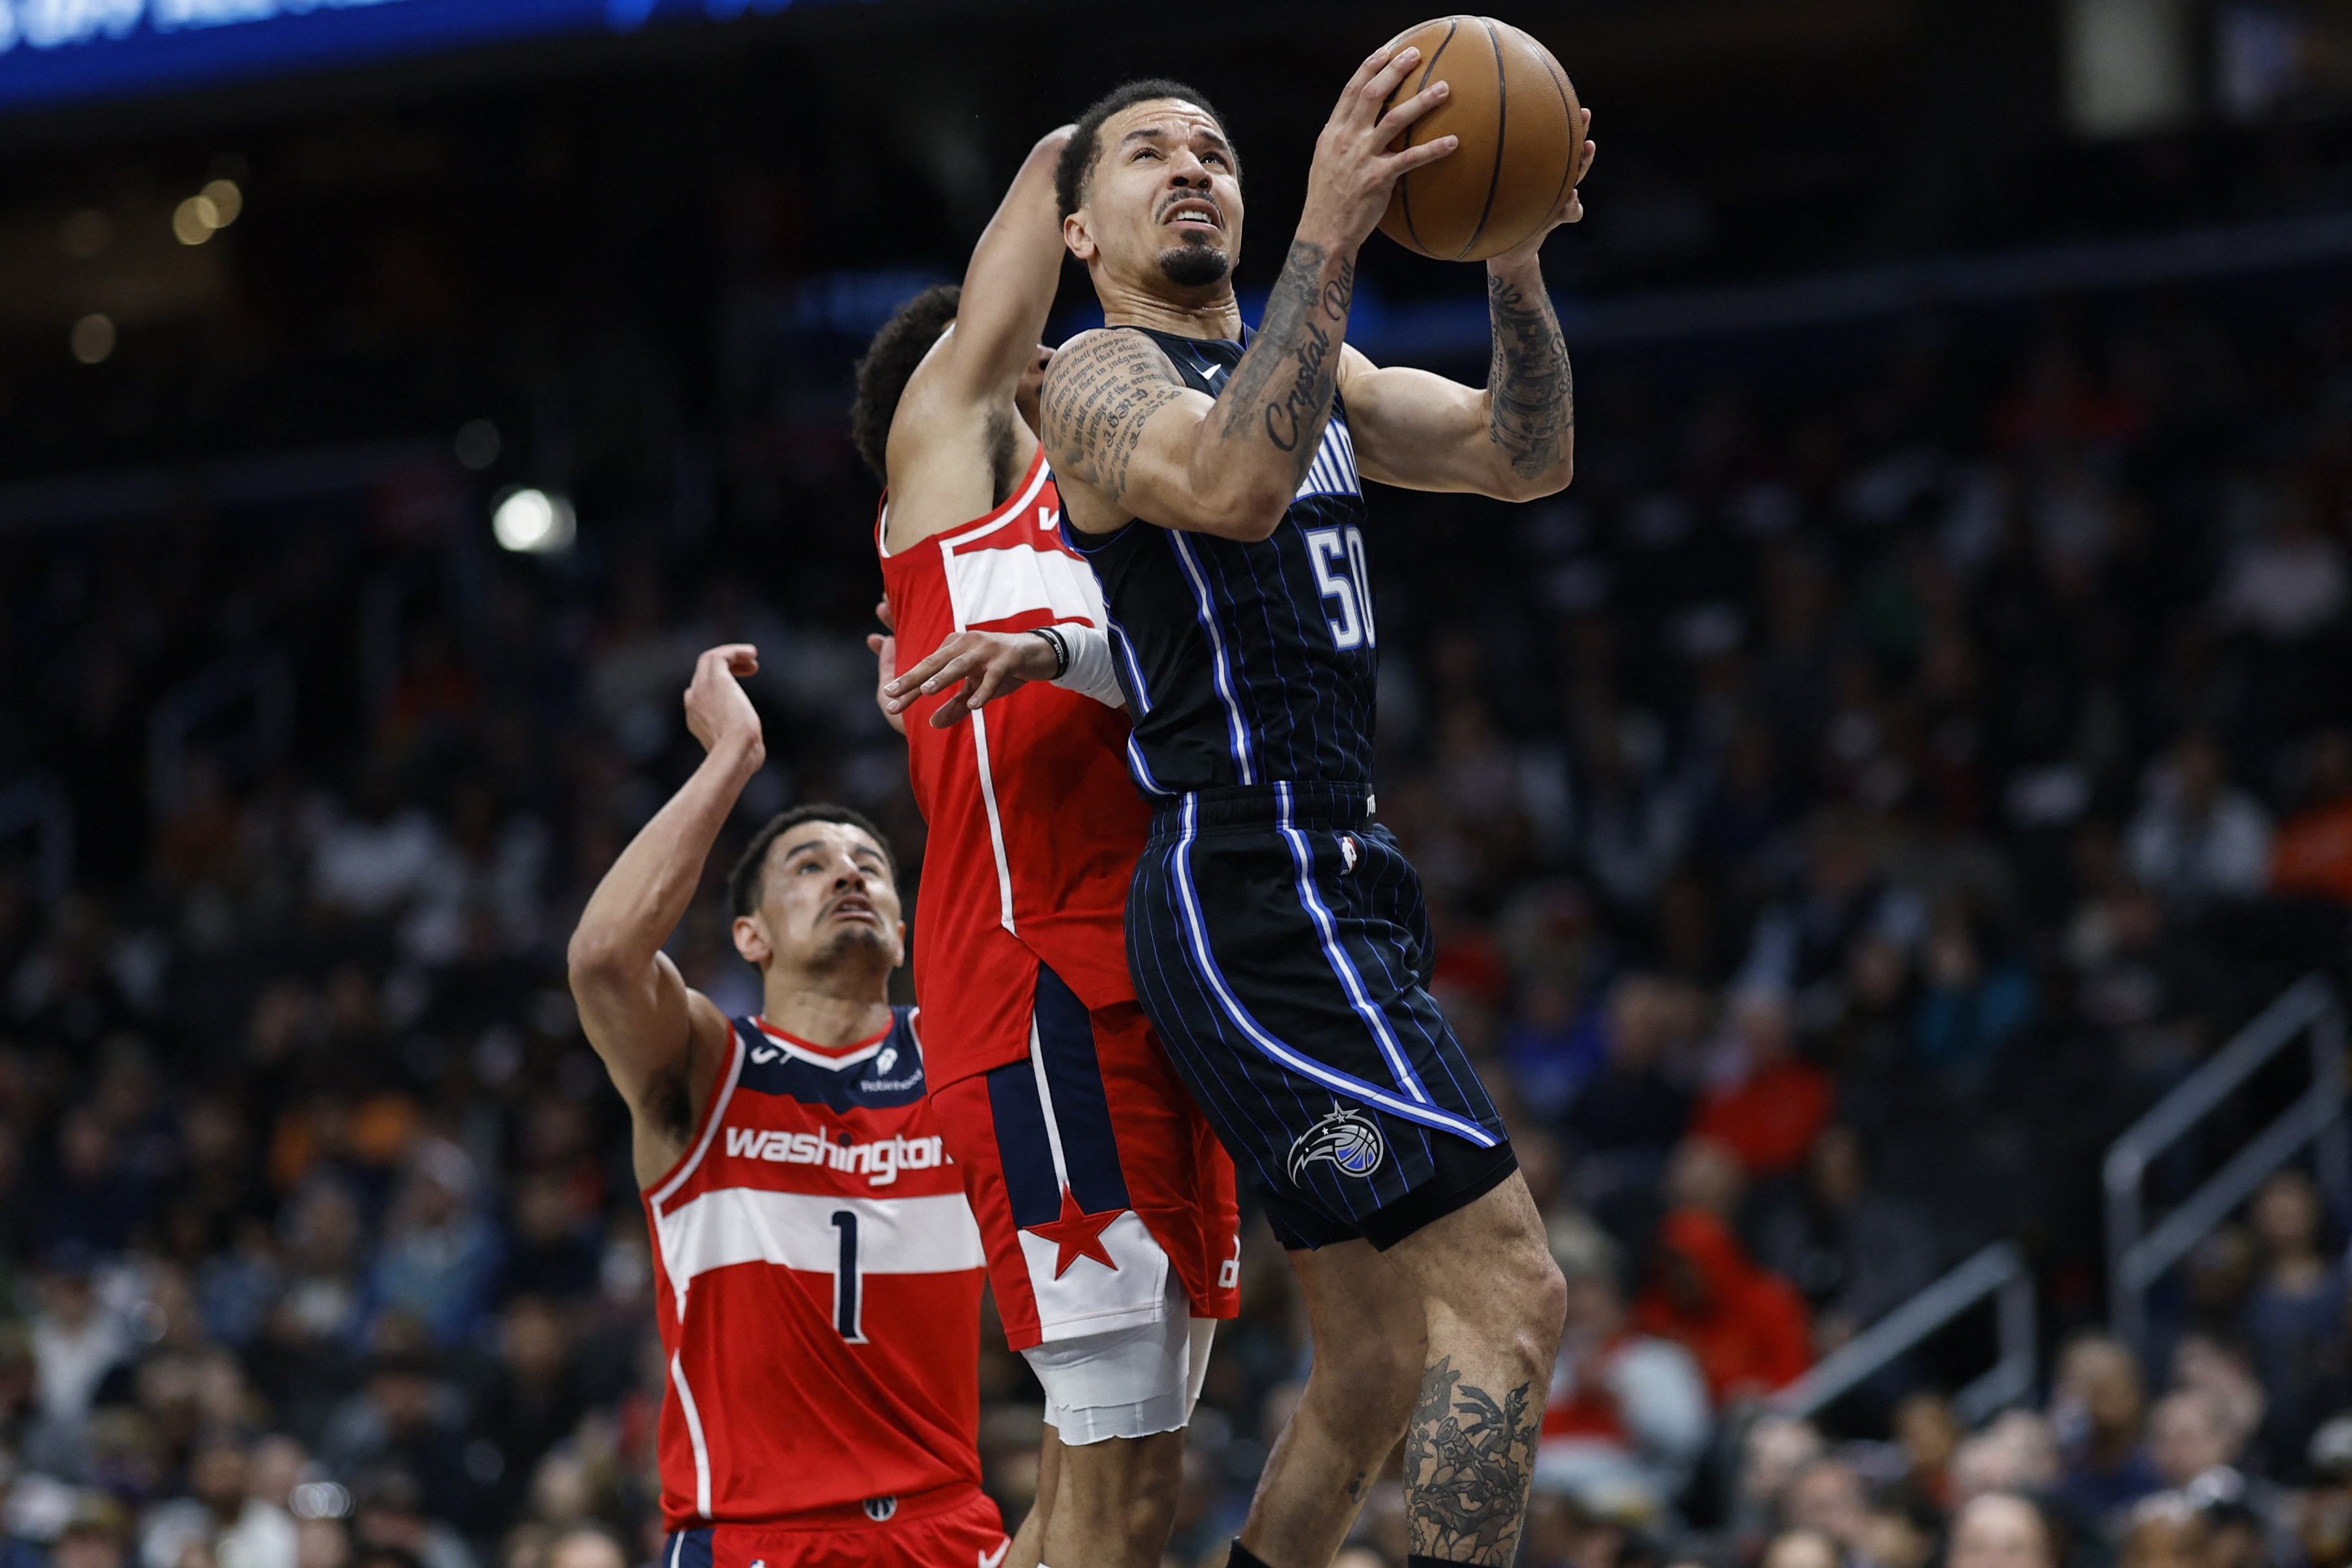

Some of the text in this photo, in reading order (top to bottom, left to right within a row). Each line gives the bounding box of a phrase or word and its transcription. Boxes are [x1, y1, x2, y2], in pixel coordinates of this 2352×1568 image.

[1095, 349, 1116, 363] that
[1095, 367, 1107, 376] in
[1266, 321, 1330, 451] Crystal
[1304, 524, 1376, 652] 50
[830, 1210, 869, 1344] 1
